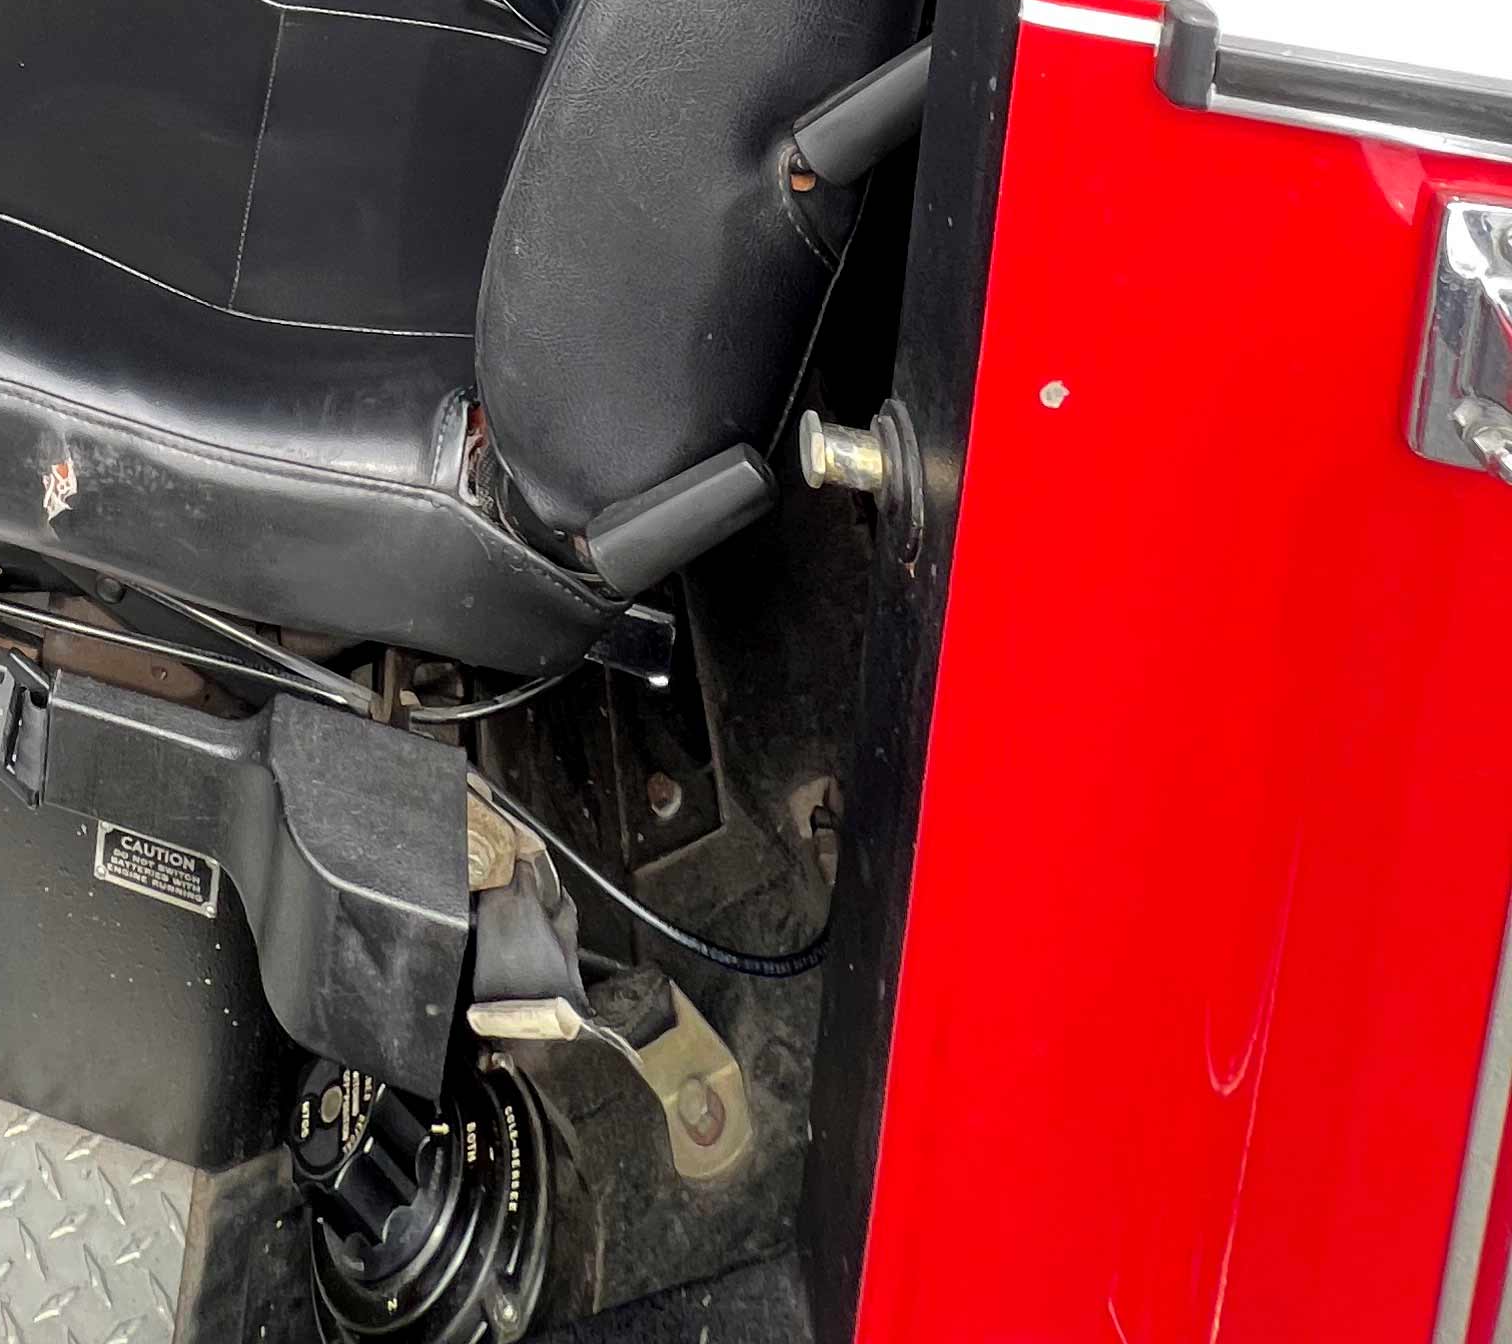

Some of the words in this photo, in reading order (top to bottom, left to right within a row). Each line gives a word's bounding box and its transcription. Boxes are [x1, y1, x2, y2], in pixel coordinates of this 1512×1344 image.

[113, 848, 129, 860] DO
[132, 855, 155, 868] NOT
[157, 864, 201, 884] SWITCH
[121, 836, 195, 872] CAUTION
[107, 862, 148, 883] ENGINE
[151, 879, 204, 903] RUNNING
[110, 855, 170, 882] BATTERIES
[172, 875, 201, 893] WITH
[466, 1121, 477, 1162] BOTH
